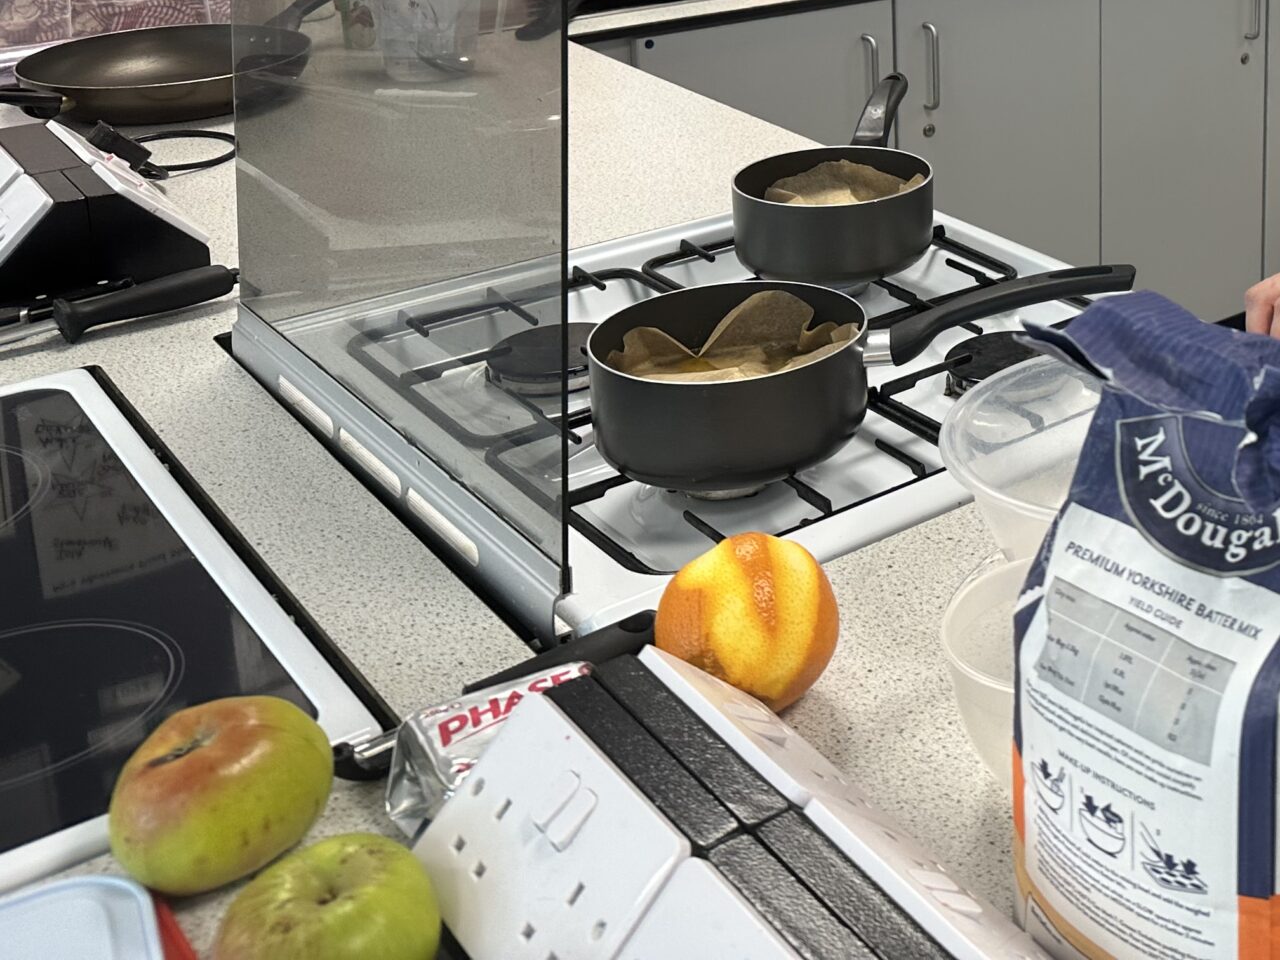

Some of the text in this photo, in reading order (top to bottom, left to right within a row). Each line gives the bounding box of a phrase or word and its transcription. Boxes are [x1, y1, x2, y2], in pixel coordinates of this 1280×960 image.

[1196, 502, 1229, 521] since
[1065, 541, 1126, 580] PREMIUM
[1127, 568, 1195, 612] YORKSHIRE
[1195, 603, 1237, 631] BATTER
[1237, 624, 1263, 640] MIX
[1128, 596, 1184, 629] YIELD GUIDE
